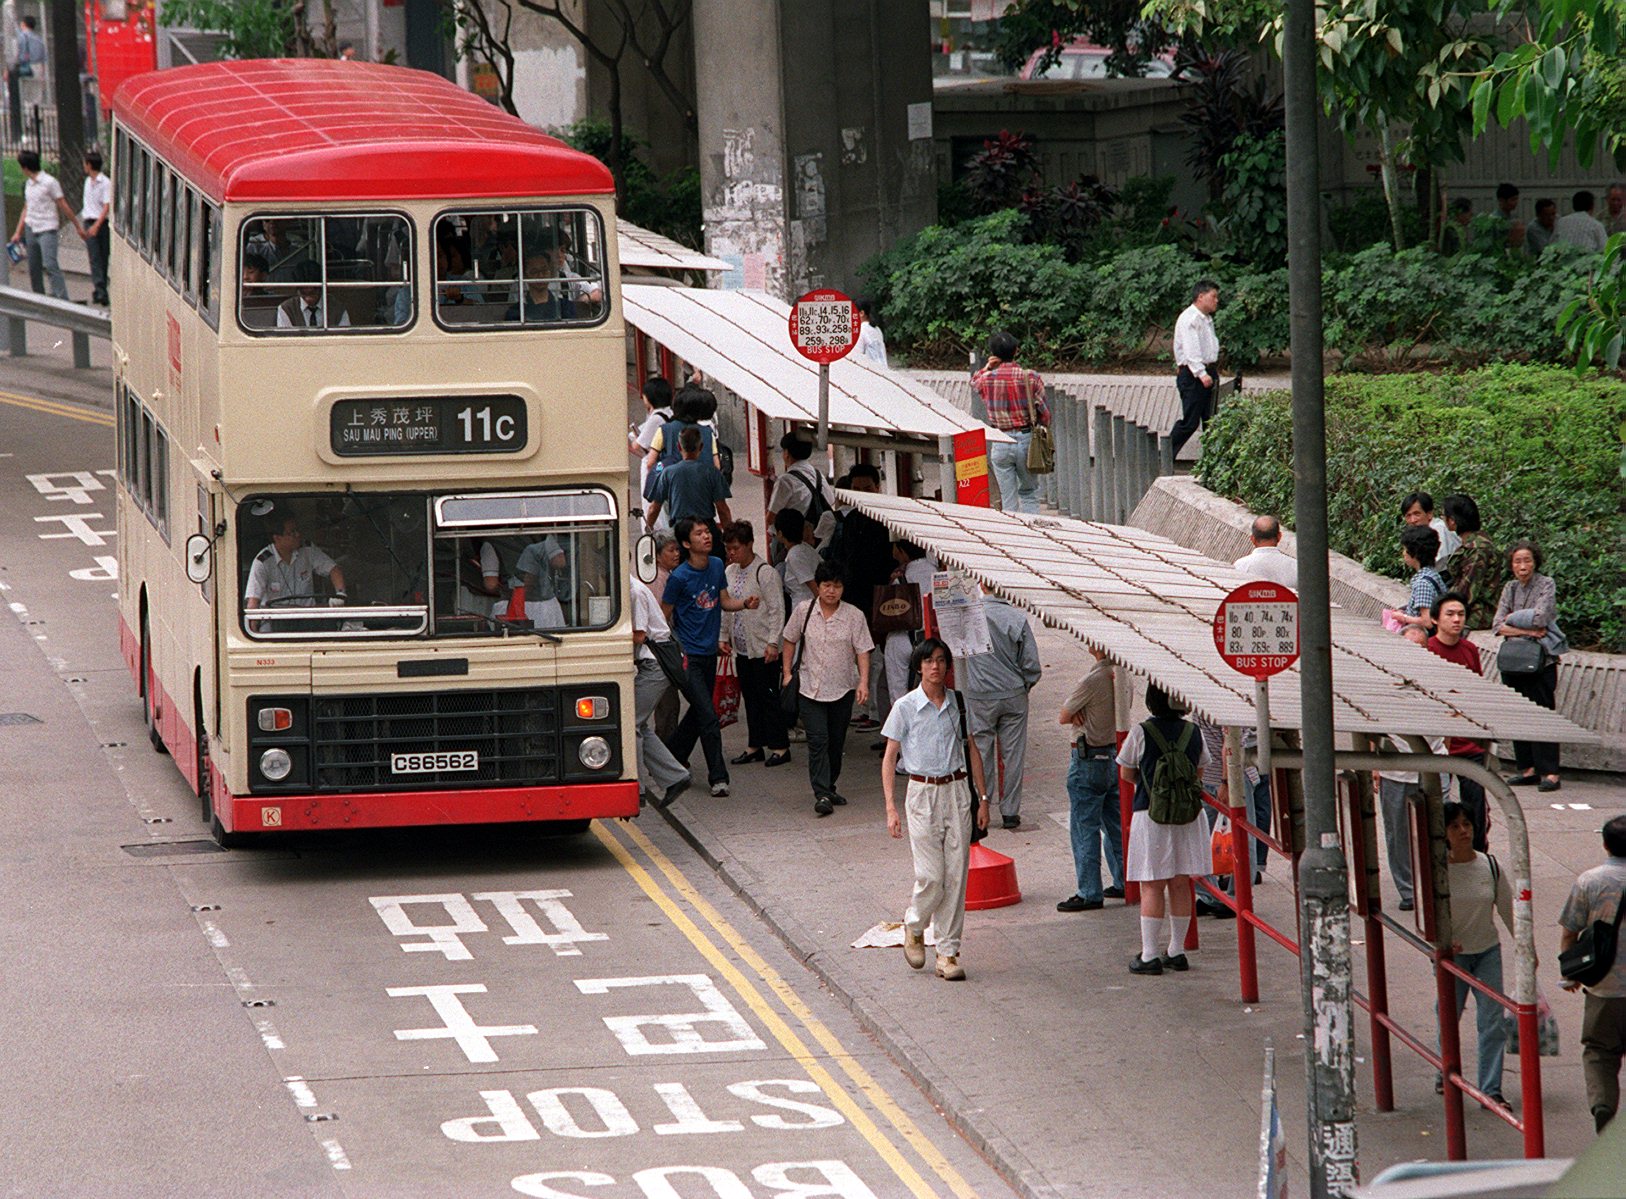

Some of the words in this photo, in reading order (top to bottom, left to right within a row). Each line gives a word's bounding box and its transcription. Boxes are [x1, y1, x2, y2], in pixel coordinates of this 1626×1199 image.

[807, 346, 823, 354] BUS
[825, 345, 845, 354] STOP
[347, 406, 433, 426] 上秀茂坪
[343, 427, 360, 442] SAU
[363, 427, 381, 441] MAU
[384, 427, 403, 441] PING
[406, 426, 438, 440] (UPPER)
[1236, 657, 1257, 668] BUS
[1261, 656, 1288, 668] STOP
[394, 753, 475, 771] CS6562
[369, 888, 610, 961] 站
[440, 1079, 846, 1143] STOP
